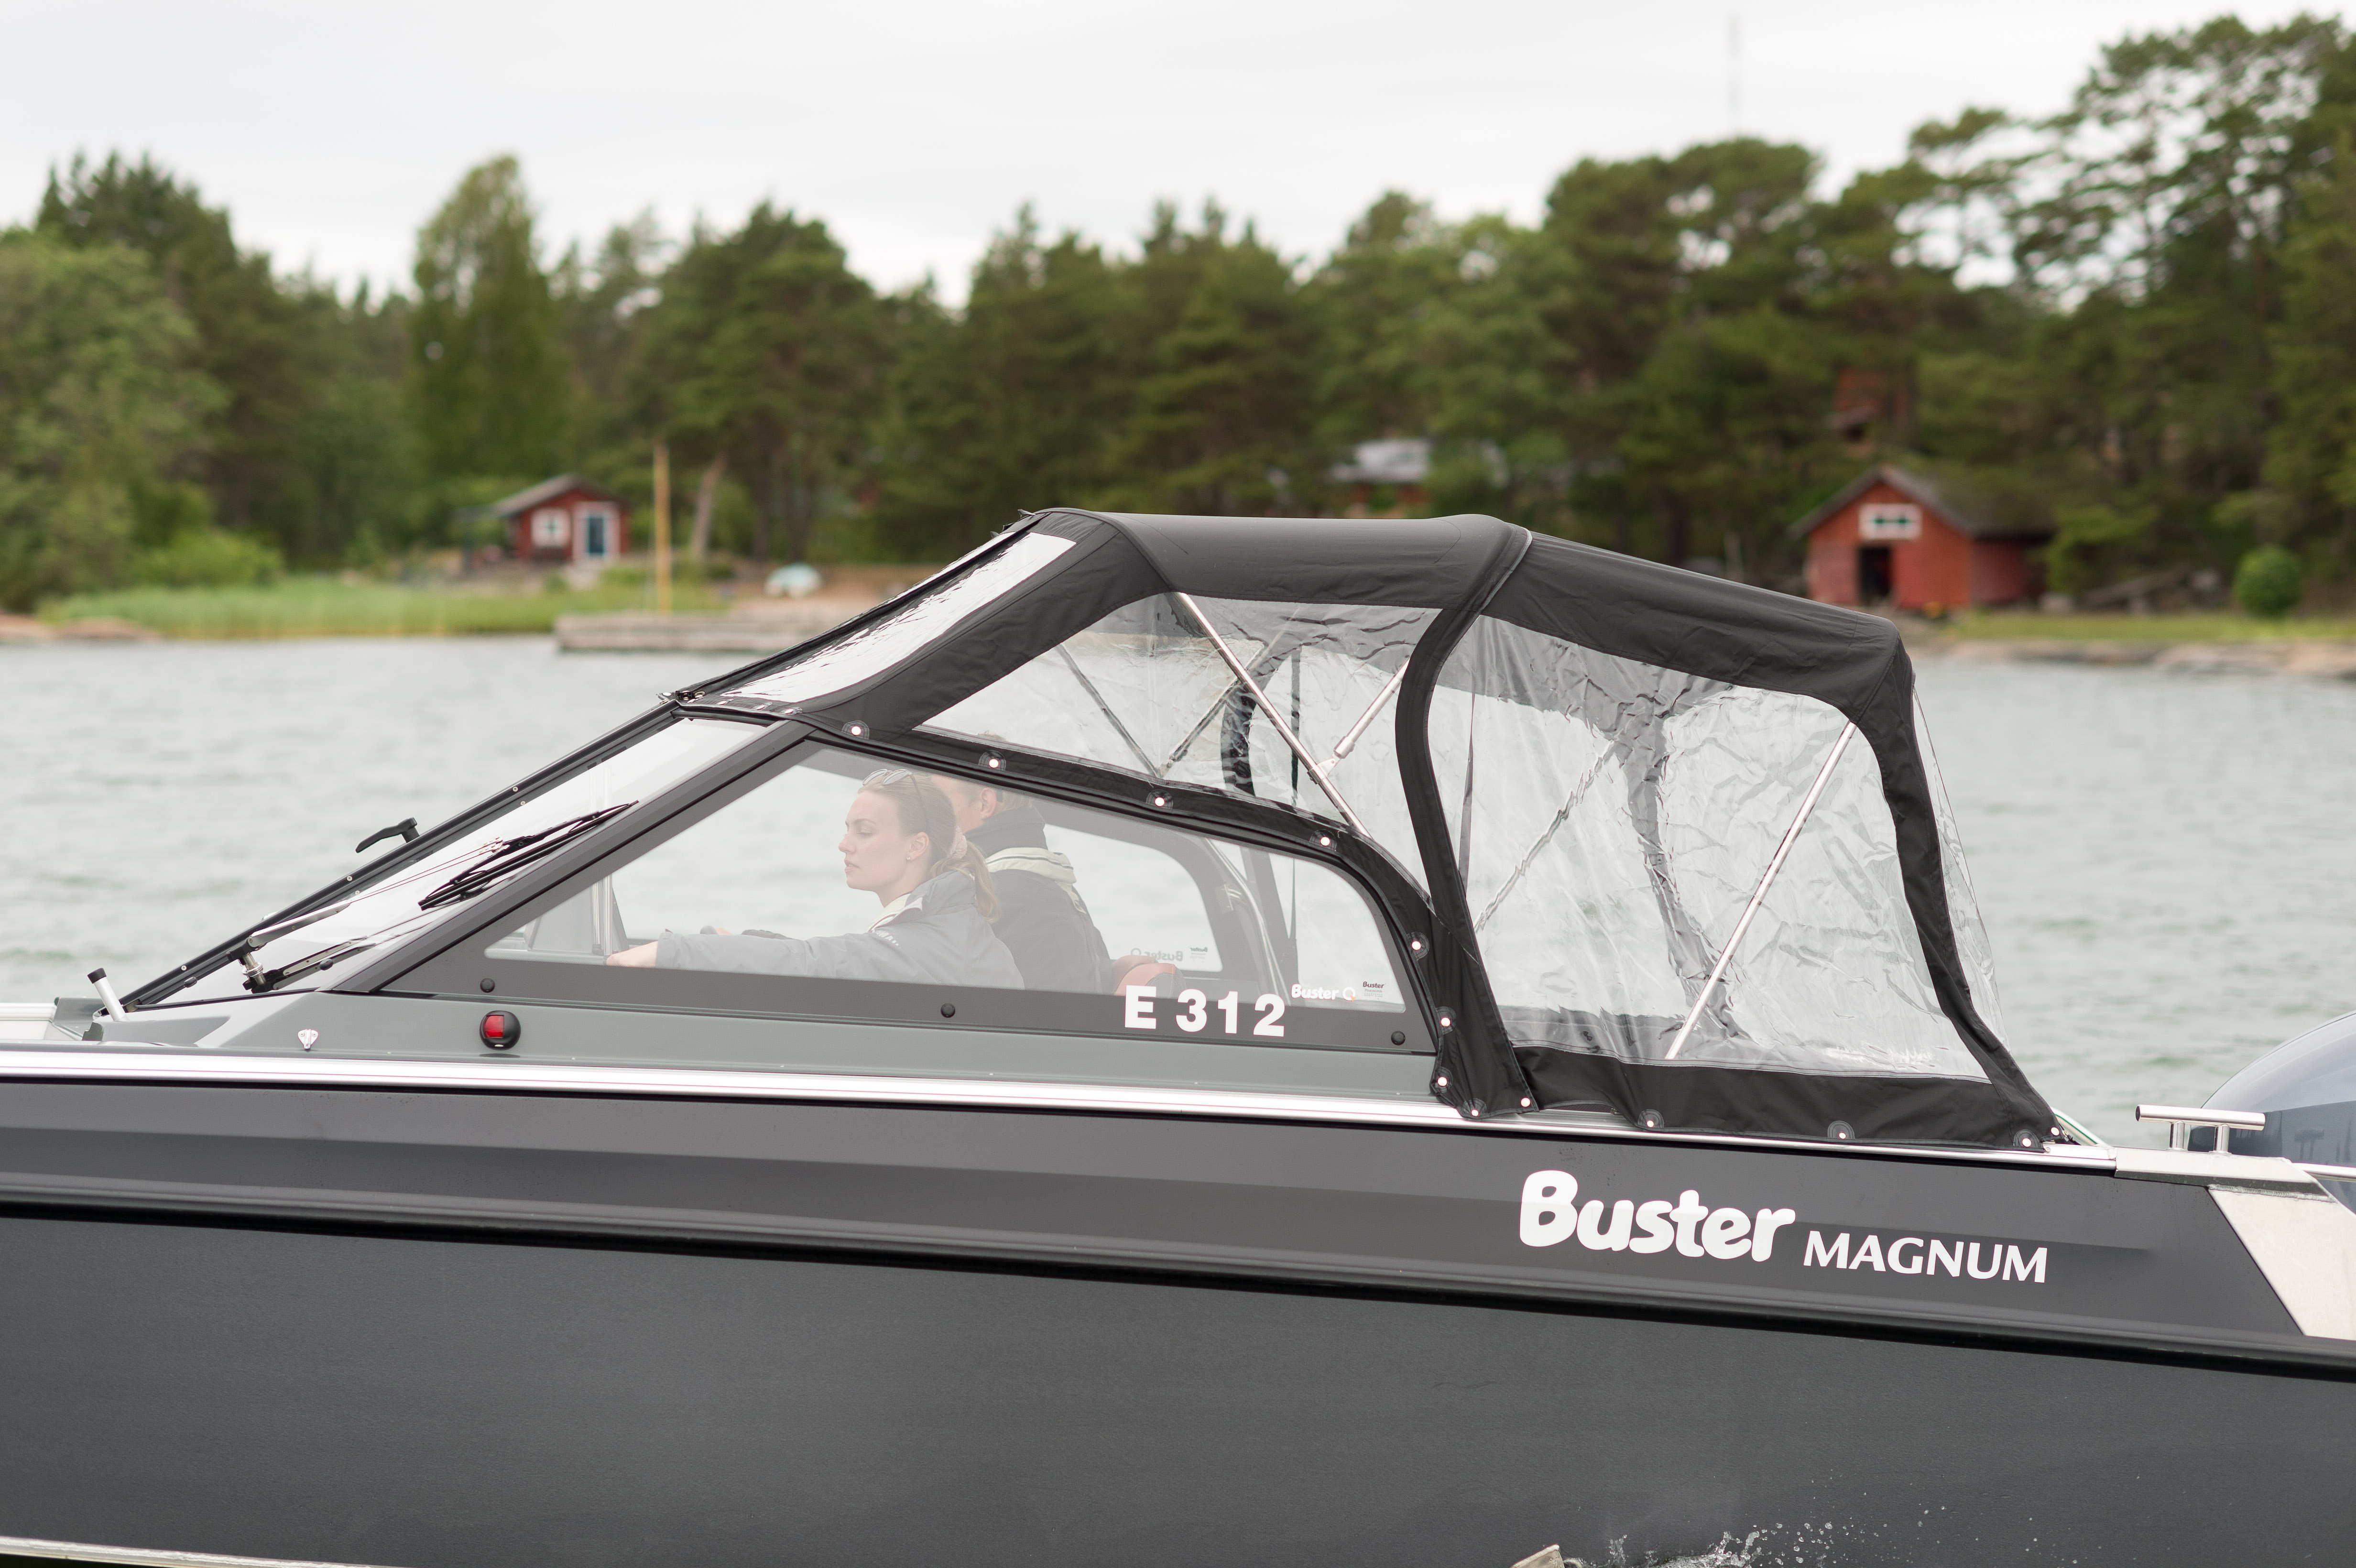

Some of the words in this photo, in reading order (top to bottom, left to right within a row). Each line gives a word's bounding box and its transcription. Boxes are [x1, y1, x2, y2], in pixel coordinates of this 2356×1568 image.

[1124, 985, 1156, 1029] E
[1176, 989, 1285, 1037] 312
[1291, 983, 1339, 1000] Buster
[1519, 1170, 1796, 1262] Buster
[1803, 1230, 2048, 1284] MAGNUM
